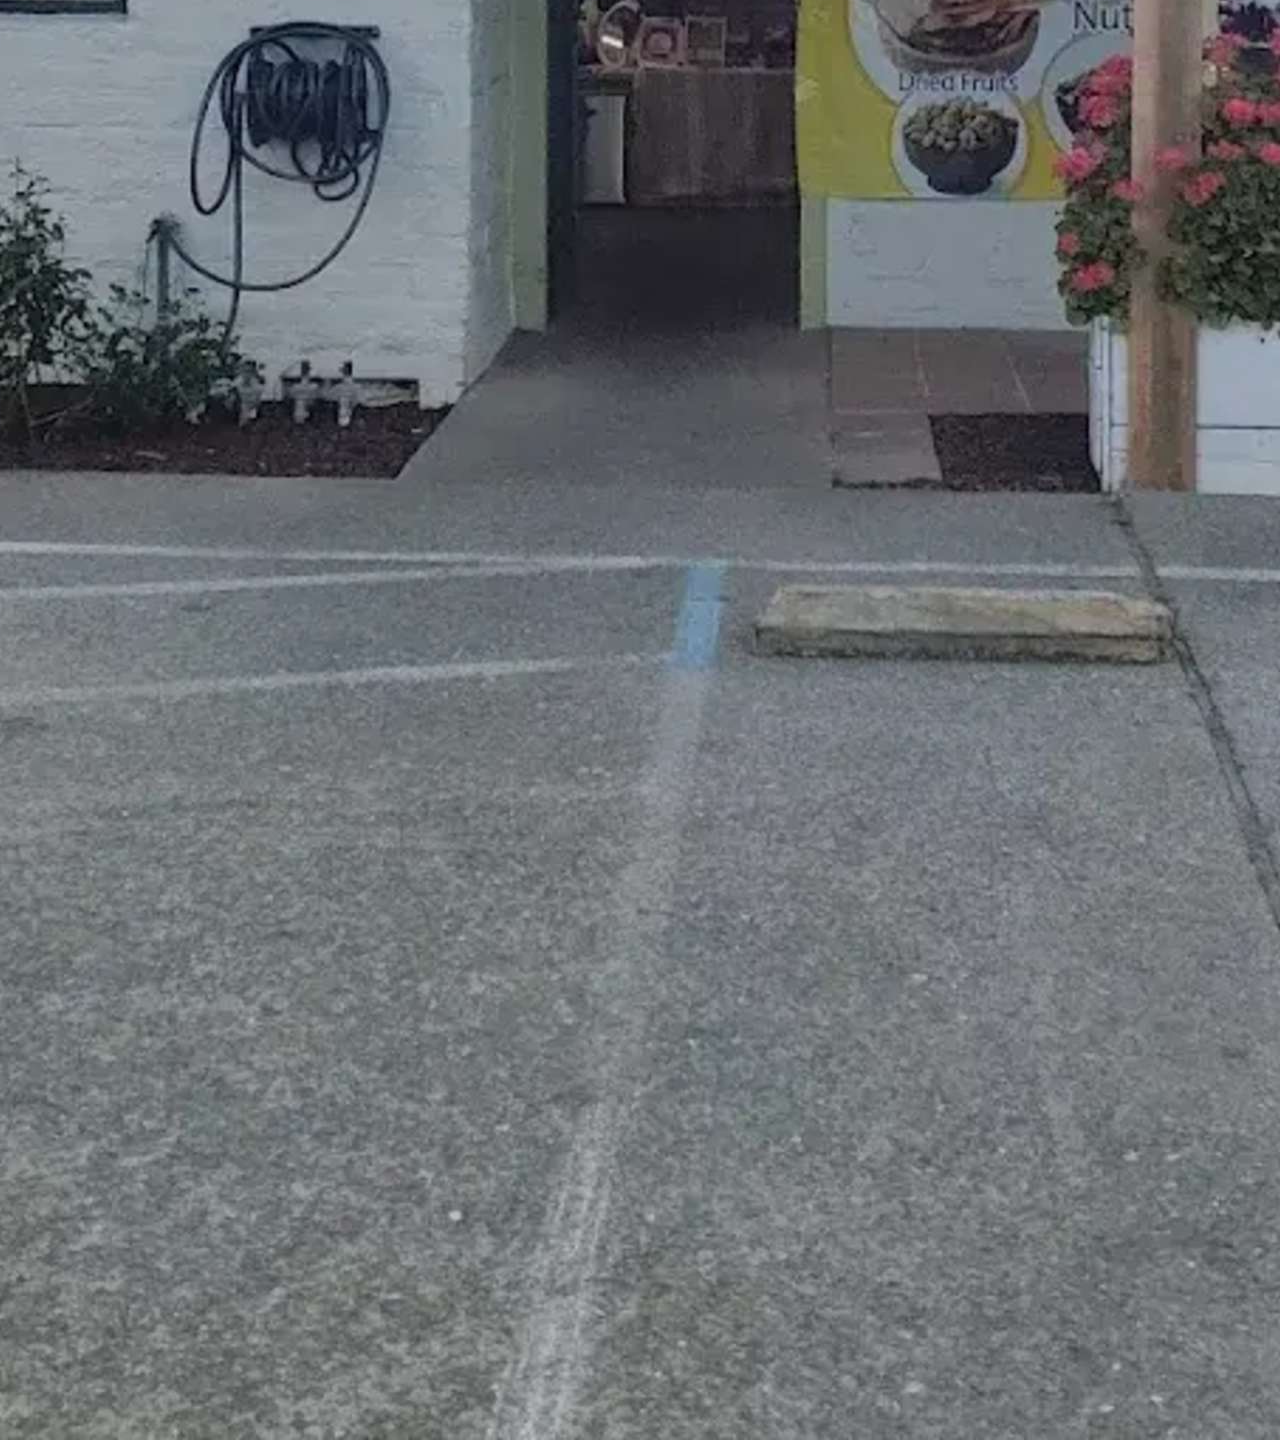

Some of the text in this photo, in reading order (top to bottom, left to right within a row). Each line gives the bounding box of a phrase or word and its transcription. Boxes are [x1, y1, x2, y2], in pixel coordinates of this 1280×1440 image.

[1072, 0, 1134, 30] Nut
[898, 72, 1019, 92] Dried Fruits
